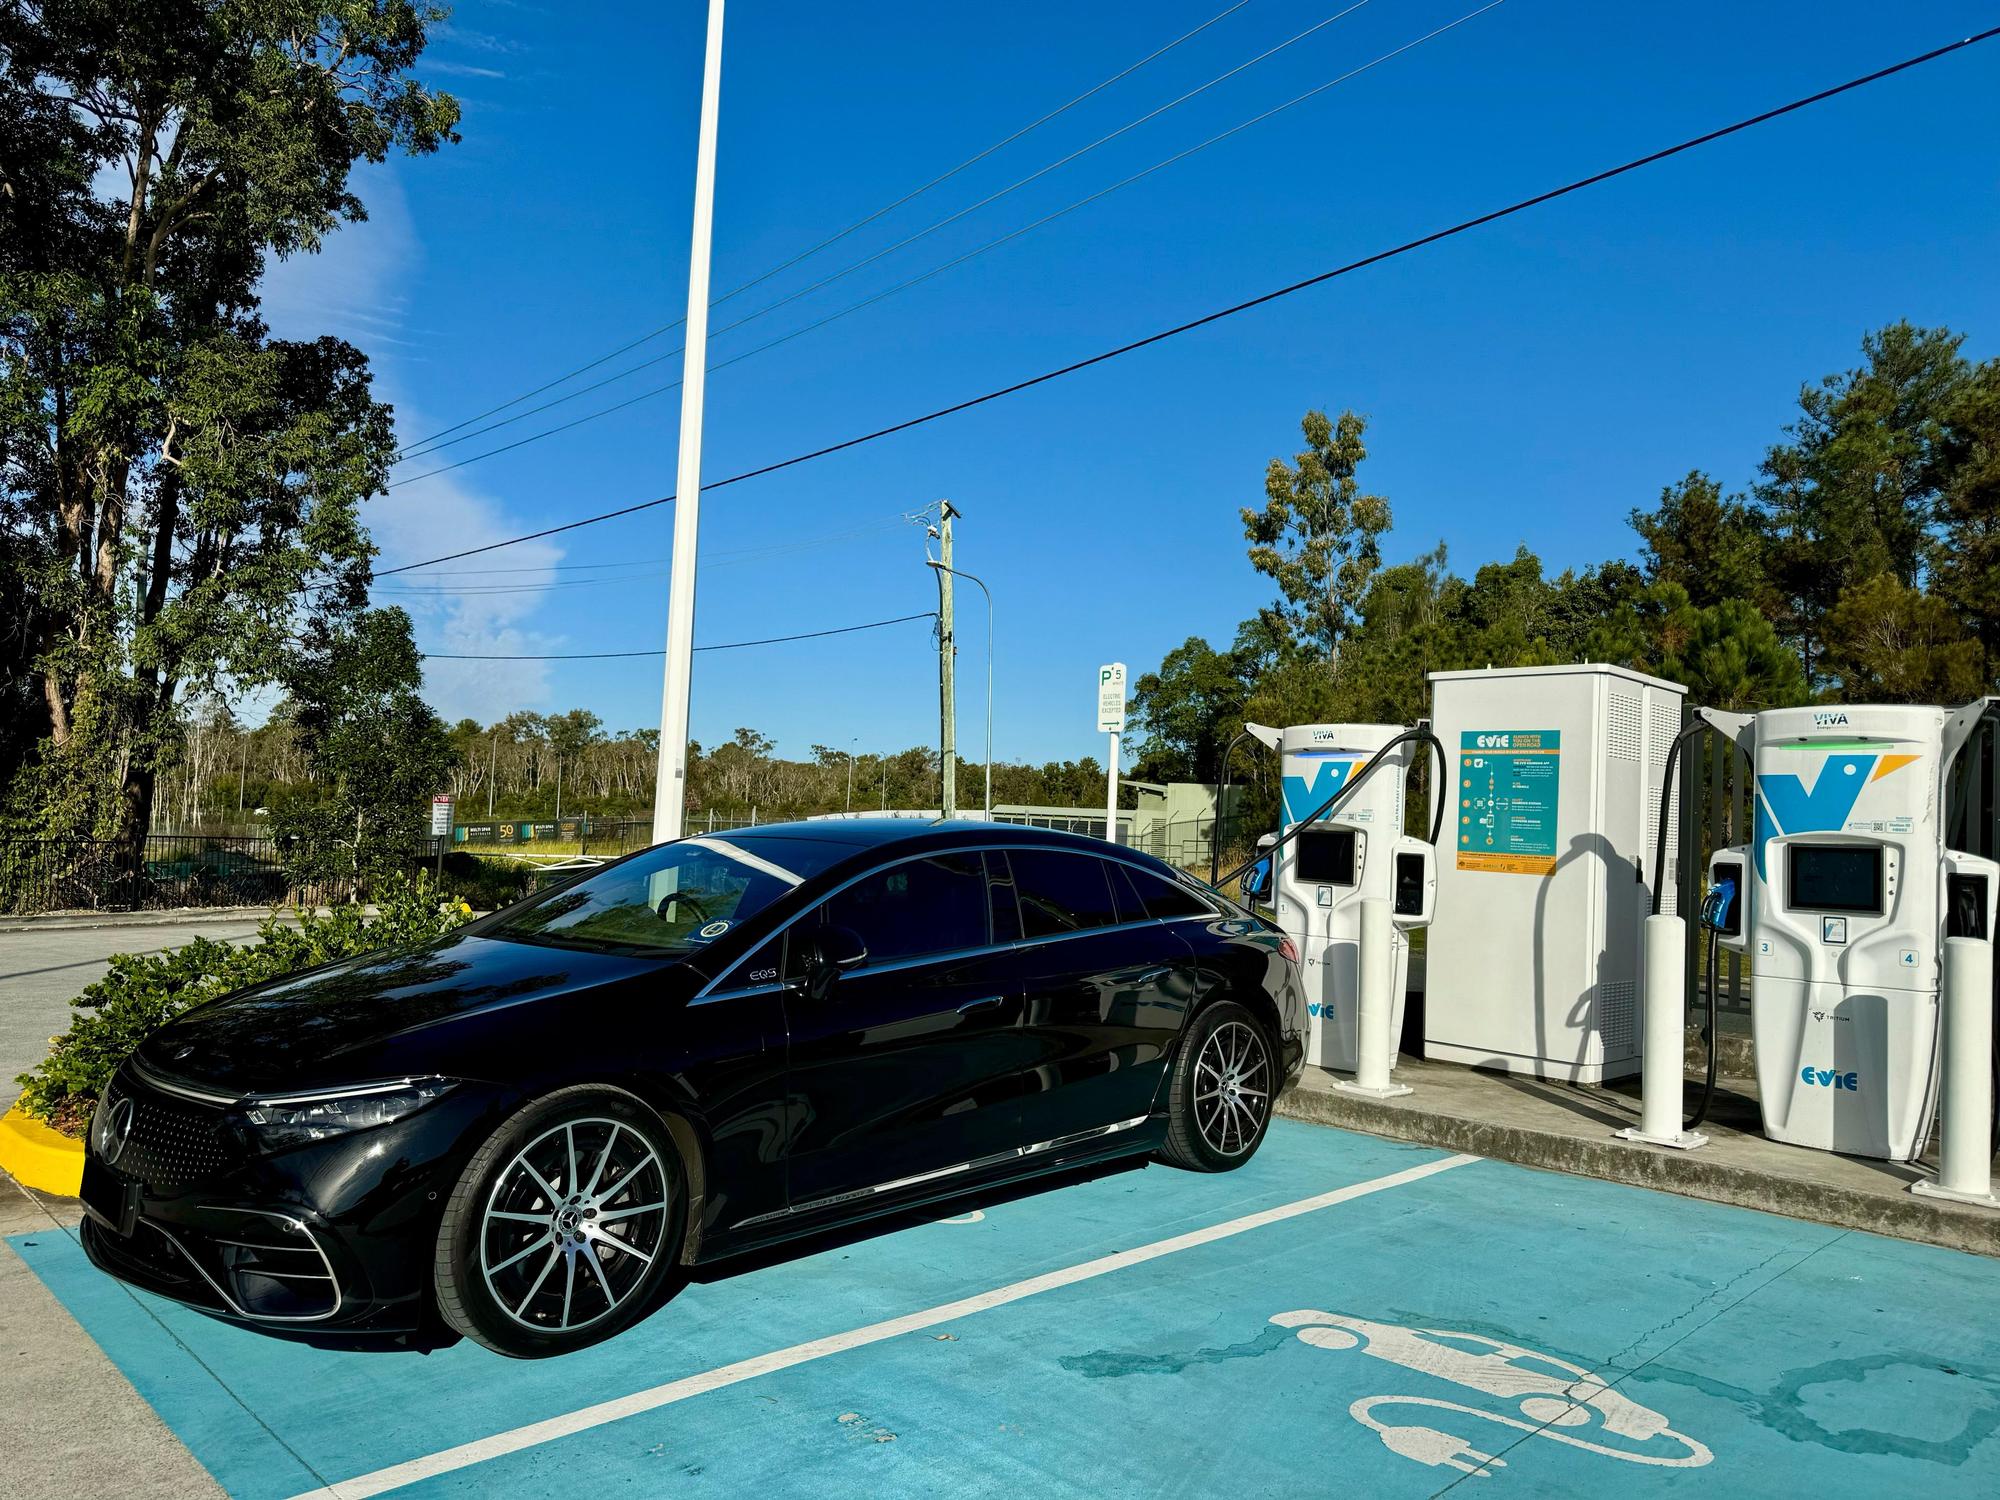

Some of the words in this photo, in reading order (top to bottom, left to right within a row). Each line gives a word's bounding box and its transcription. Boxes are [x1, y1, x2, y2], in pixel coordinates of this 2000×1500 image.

[1102, 671, 1111, 686] P
[1115, 670, 1121, 679] 5
[1813, 712, 1849, 726] VIVA
[1312, 730, 1334, 740] VIVA
[500, 824, 514, 838] 50
[1281, 904, 1286, 912] 1
[1761, 942, 1769, 952] 3
[1904, 953, 1914, 964] 4
[750, 967, 777, 981] EQS
[1308, 1002, 1334, 1020] VIE
[1801, 1066, 1858, 1092] EVIE
